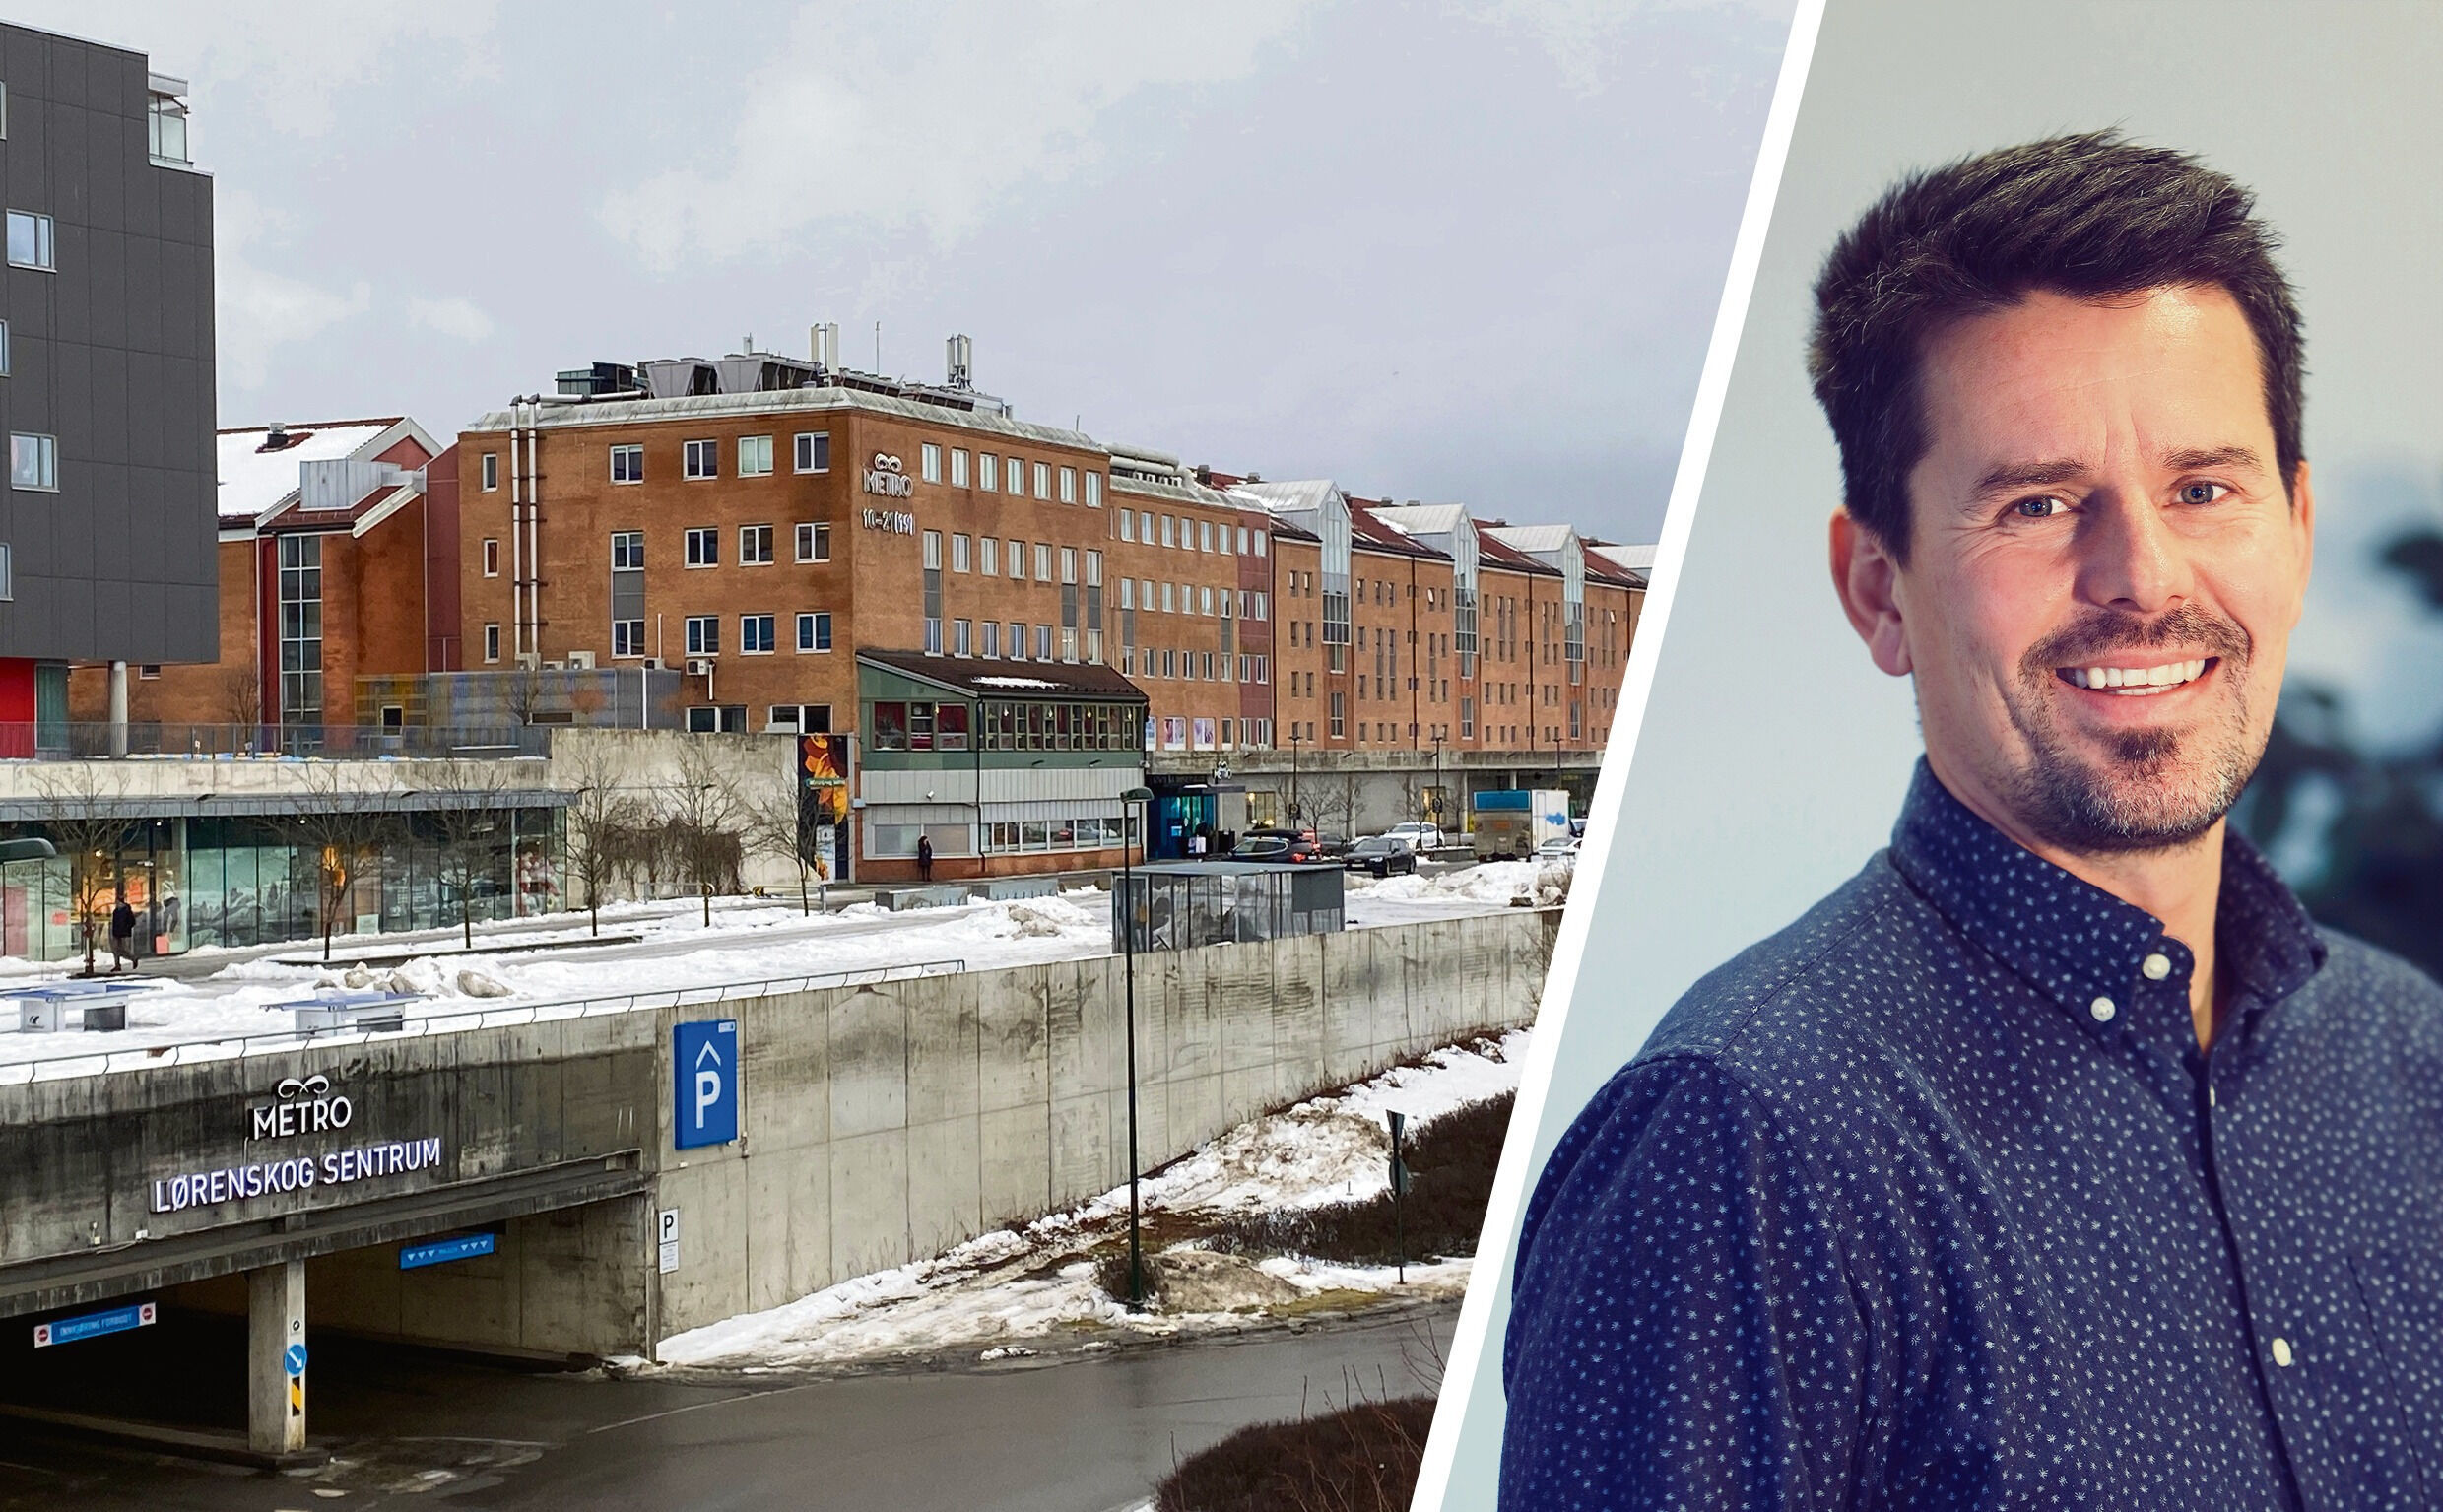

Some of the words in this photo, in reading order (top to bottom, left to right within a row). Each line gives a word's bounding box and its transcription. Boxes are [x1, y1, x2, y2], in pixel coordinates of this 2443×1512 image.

[863, 468, 913, 498] METRO
[253, 1096, 352, 1141] METRO
[696, 1070, 721, 1129] P
[155, 1157, 315, 1213] LØRENSKOG
[323, 1137, 440, 1184] SENTRUM
[664, 1214, 675, 1239] P
